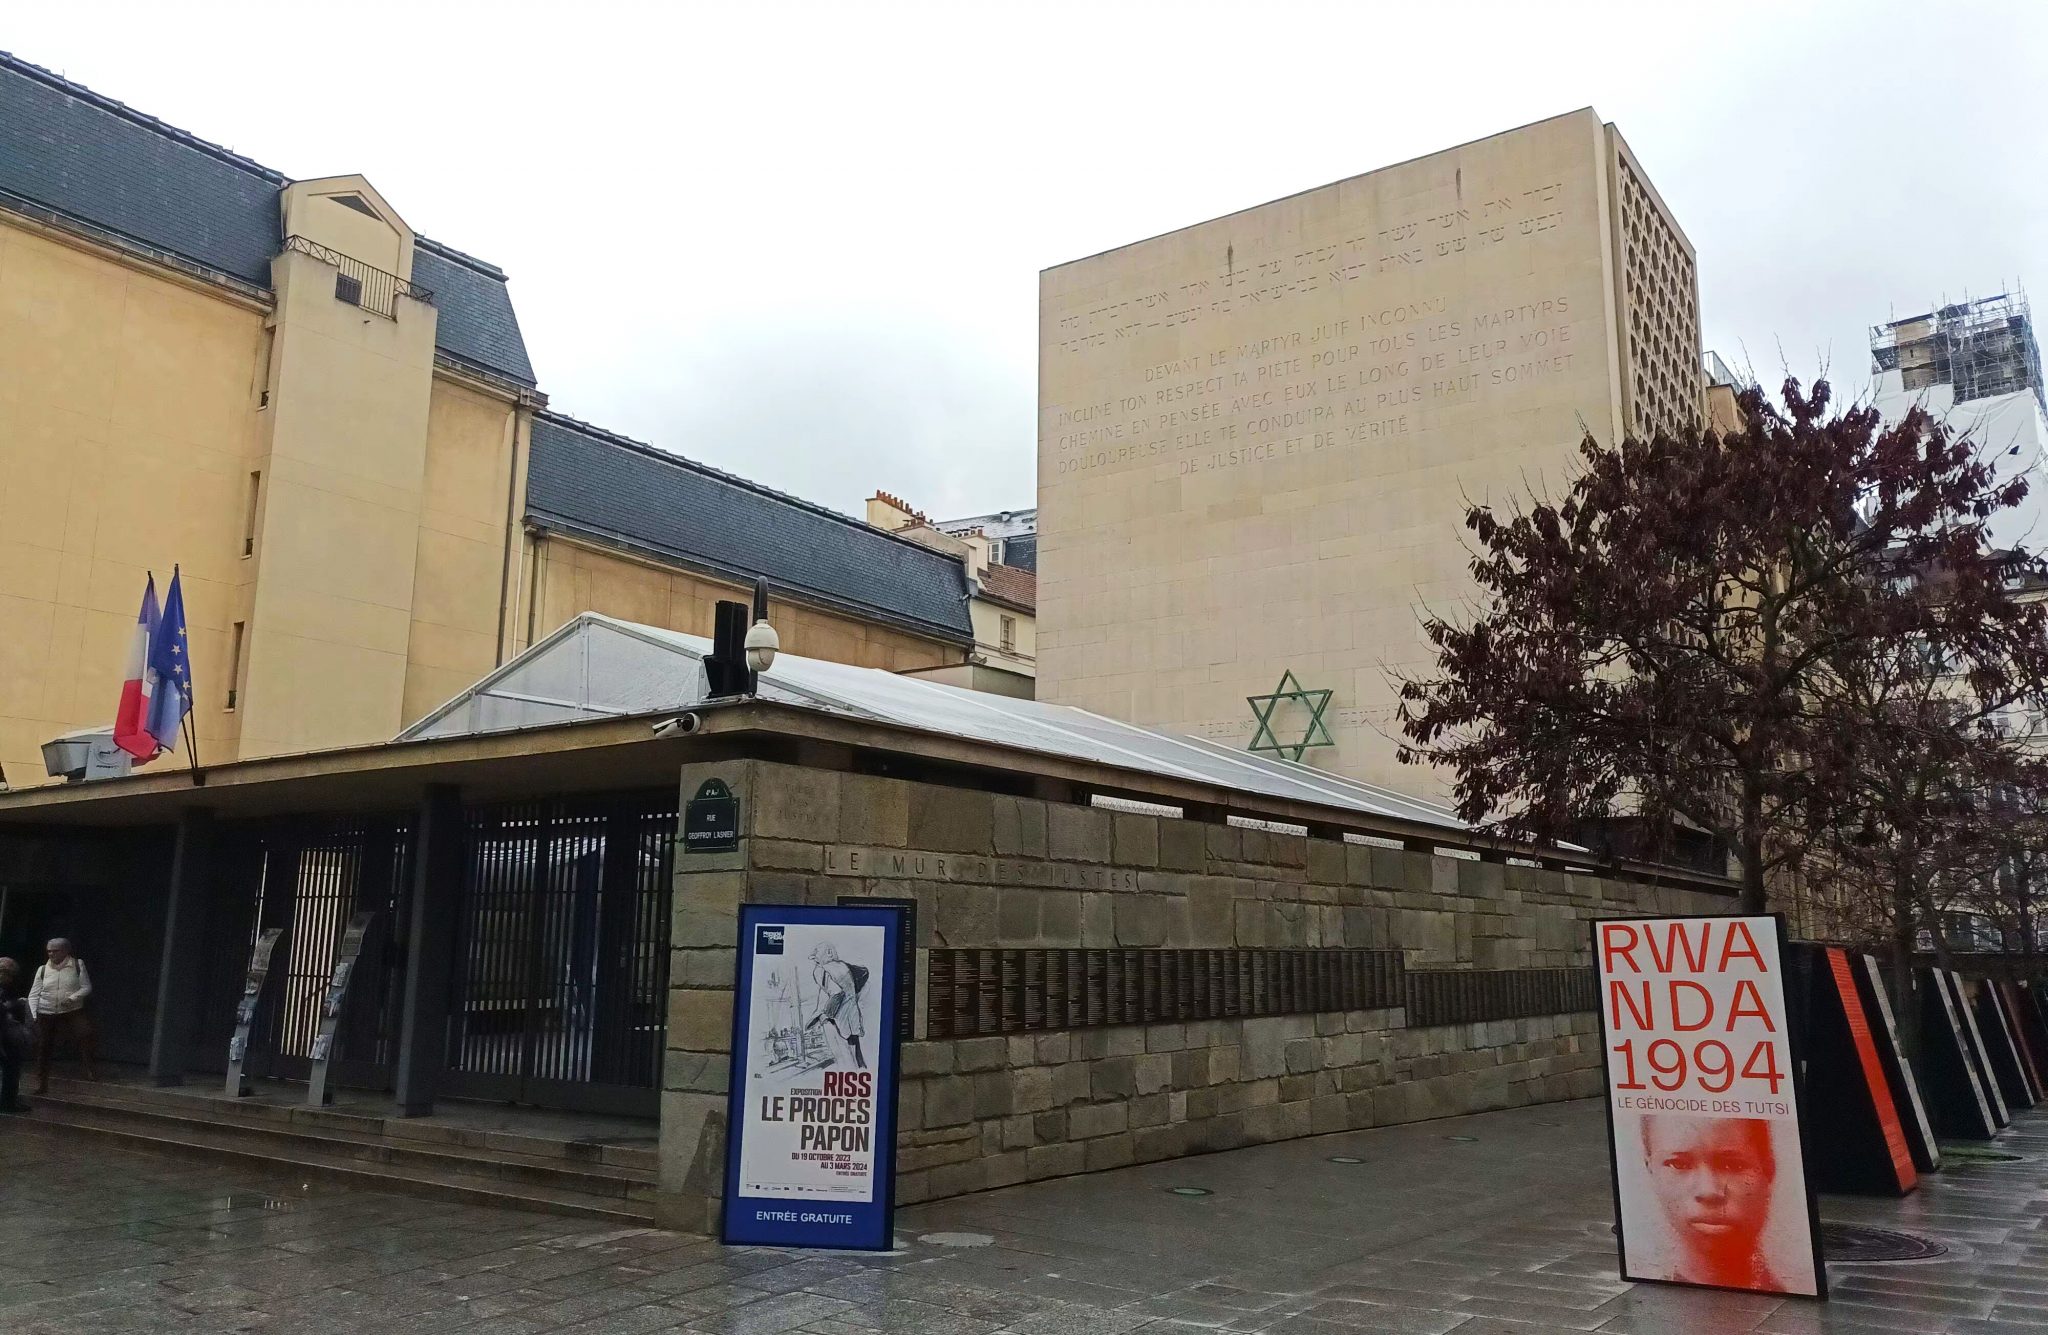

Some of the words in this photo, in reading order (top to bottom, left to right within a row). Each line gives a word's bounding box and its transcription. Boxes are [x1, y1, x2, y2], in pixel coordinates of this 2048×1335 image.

[1145, 356, 1201, 382] DEVANT
[1210, 350, 1226, 367] LE
[1237, 332, 1301, 359] MARTYR
[1310, 320, 1350, 342] JUIF
[1361, 296, 1446, 332] INCONNU
[1058, 402, 1112, 427] INCLINE
[1120, 394, 1147, 412] TON
[1156, 377, 1224, 404] RESPECT
[1232, 371, 1248, 387] TA
[1312, 345, 1359, 368] POUR
[1370, 332, 1416, 354] TOUS
[1428, 322, 1462, 342] LES
[1474, 296, 1568, 332] MARTYRS
[1059, 424, 1123, 450] CHEMINE
[1132, 418, 1150, 434] EN
[1232, 391, 1273, 413] AVEC
[1284, 381, 1318, 402] EUX
[1328, 374, 1347, 392] LE
[1359, 361, 1409, 386] LONG
[1422, 352, 1446, 372] DE
[1458, 340, 1507, 364] LEUR
[1520, 325, 1571, 347] VOIE
[1176, 430, 1211, 450] ELLE
[1220, 424, 1238, 440] TE
[1344, 397, 1366, 416] AU
[1377, 386, 1423, 409] PLUS
[1434, 374, 1481, 398] HAUT
[1491, 354, 1574, 385] SOMMET
[1180, 458, 1198, 475] DE
[1207, 443, 1274, 470] JUSTICE
[1286, 437, 1303, 455] ET
[1314, 431, 1336, 448] DE
[688, 832, 712, 840] GEOFFROY
[706, 814, 716, 822] RUE
[828, 852, 859, 870] LE
[892, 855, 946, 876] MUR
[978, 862, 1023, 882] DES
[1049, 866, 1130, 889] JUSTES
[1602, 922, 1768, 973] RWA
[1610, 980, 1776, 1032] NDA
[1614, 1038, 1785, 1094] 1994
[790, 1088, 822, 1096] EXPOSITION
[824, 1072, 872, 1098] RISS
[762, 1096, 784, 1122] LE
[790, 1097, 870, 1124] PROCÈS
[1618, 1096, 1632, 1110] LE
[1636, 1096, 1708, 1112] GÉNOCIDE
[1713, 1100, 1741, 1114] DES
[1746, 1102, 1790, 1116] TUTSI
[800, 1125, 870, 1152] PAPON
[808, 1153, 834, 1161] OCTOBRE
[835, 1154, 850, 1162] 2023
[756, 1210, 798, 1222] ENTRÉE
[800, 1212, 852, 1224] GRATUITE
